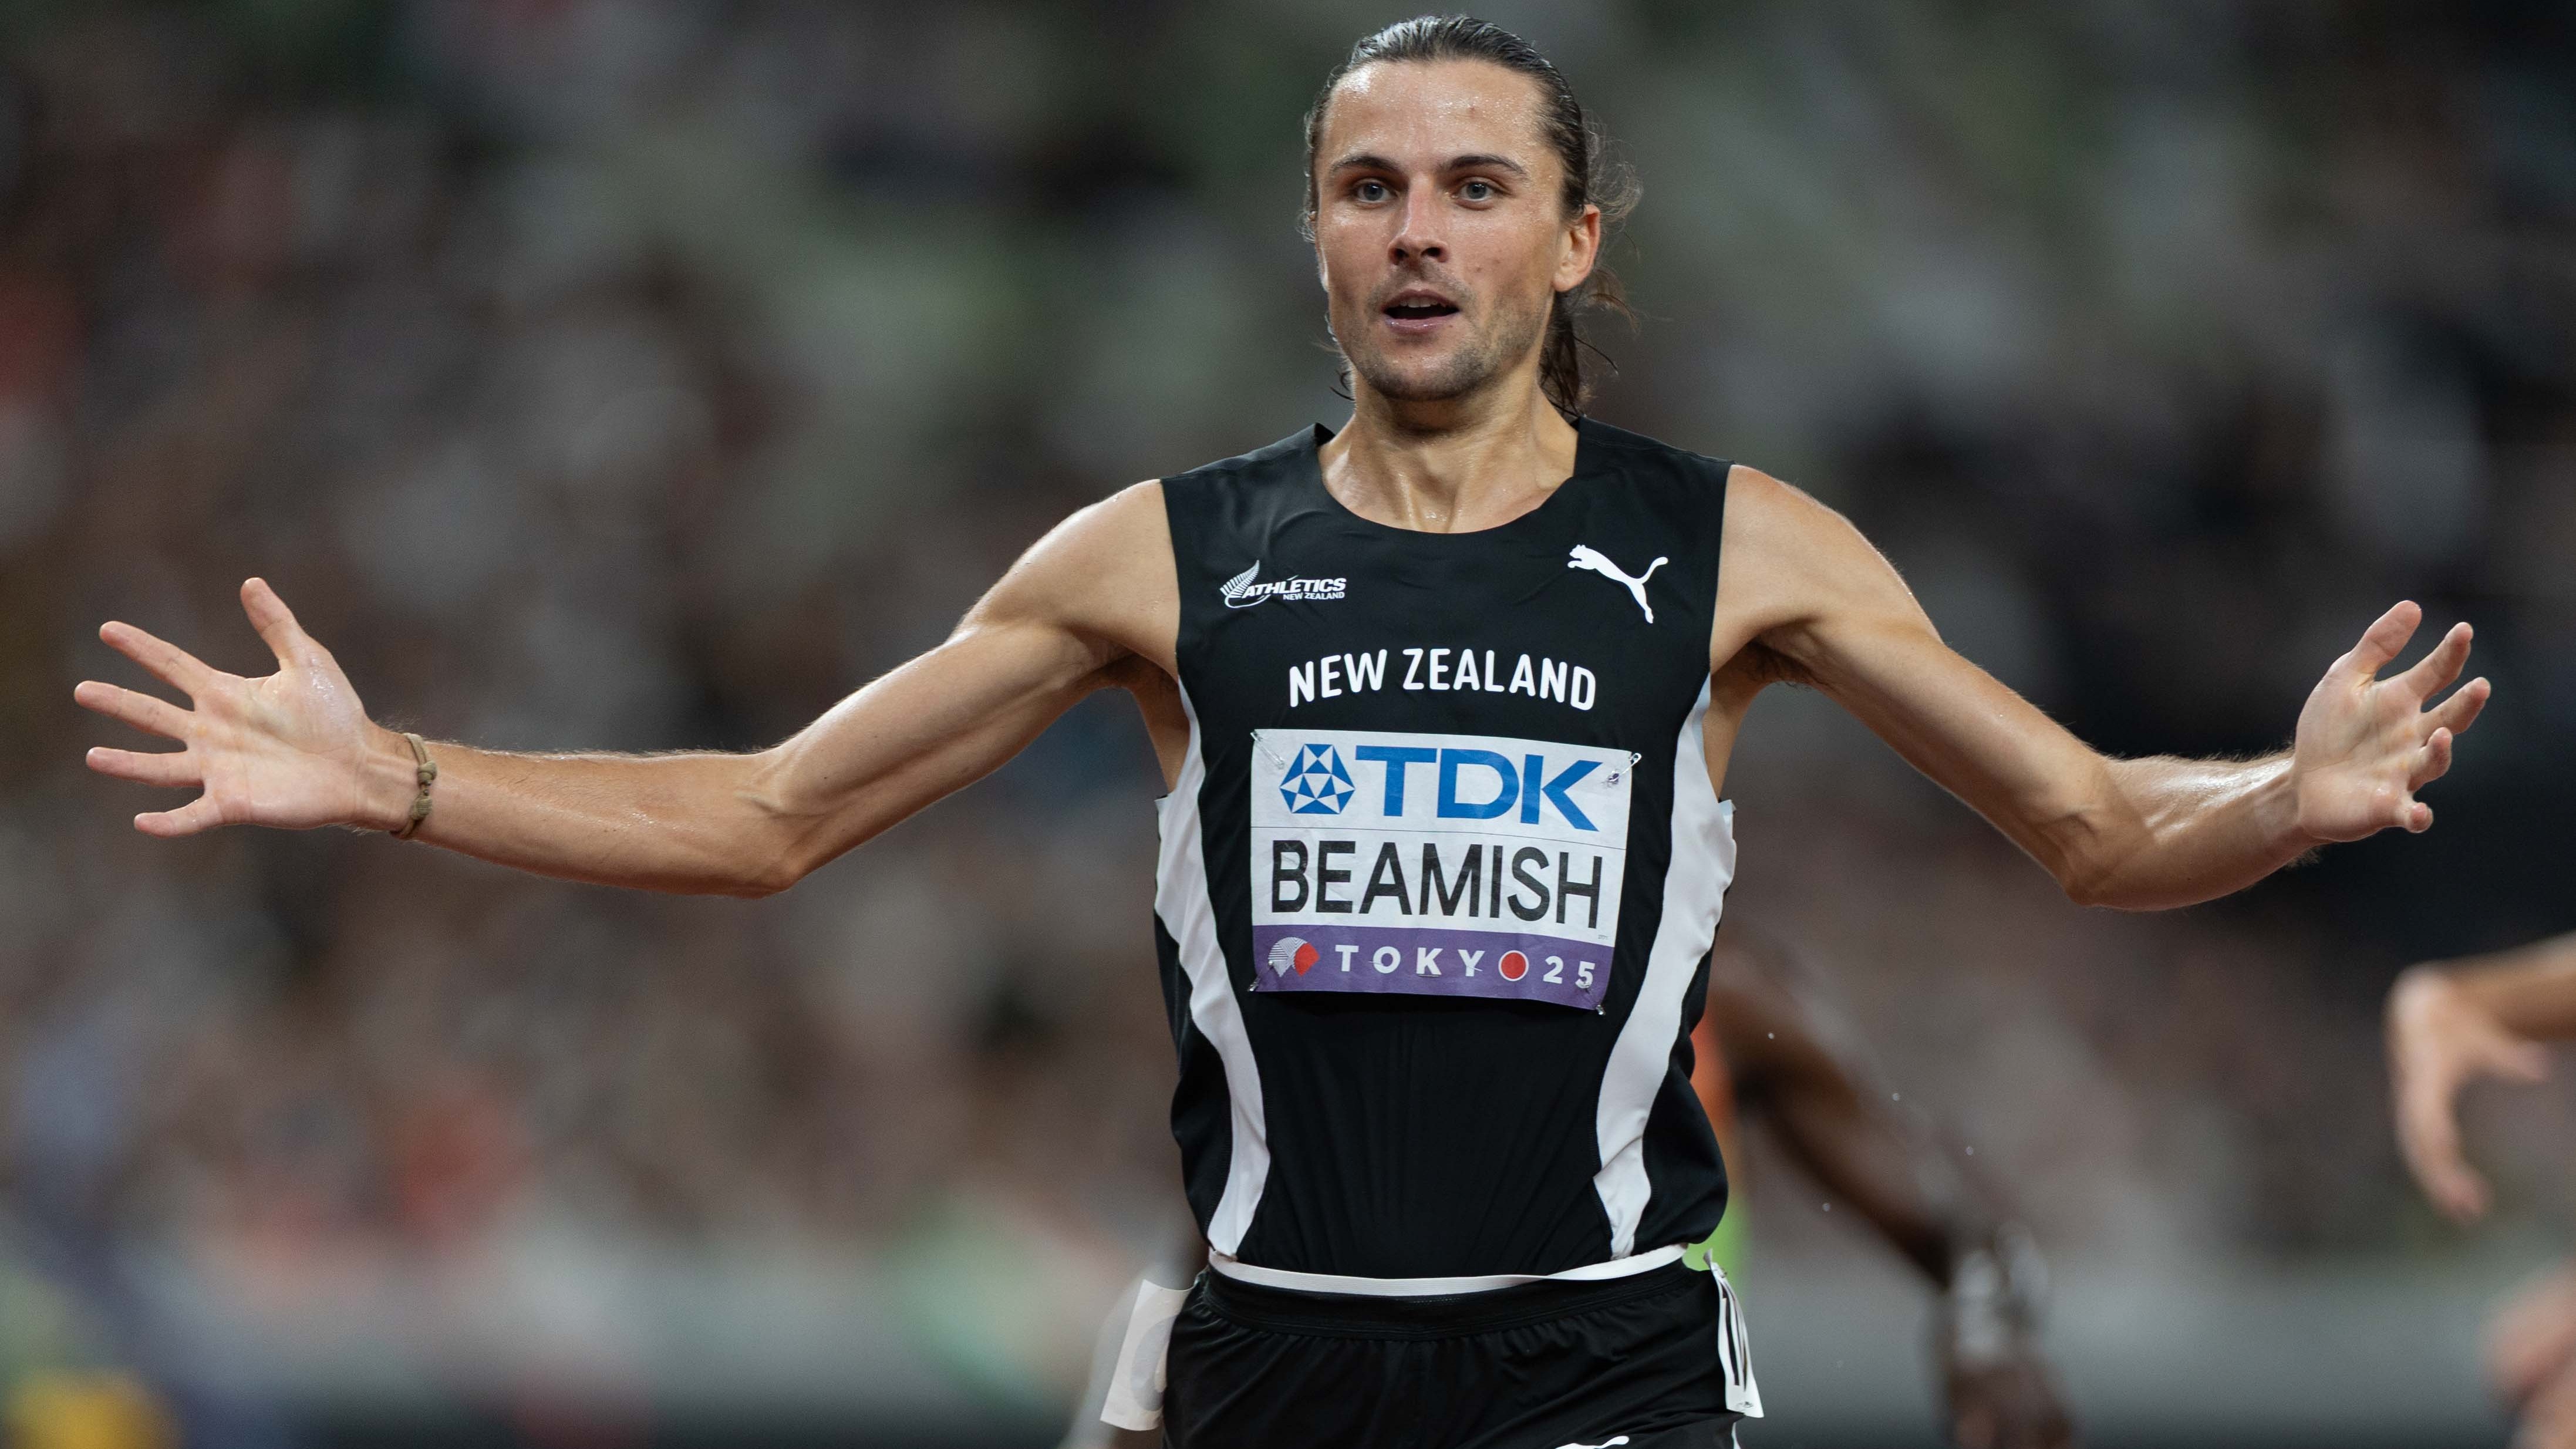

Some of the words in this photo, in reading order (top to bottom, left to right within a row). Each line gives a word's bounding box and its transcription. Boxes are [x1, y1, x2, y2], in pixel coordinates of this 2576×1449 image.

[1242, 578, 1347, 599] ATHLETICS
[1304, 592, 1346, 600] ZEALAND
[1289, 649, 1388, 707] NEW
[1402, 648, 1596, 710] ZEALAND
[1354, 744, 1603, 832] TDK
[1272, 840, 1603, 929] BEAMISH
